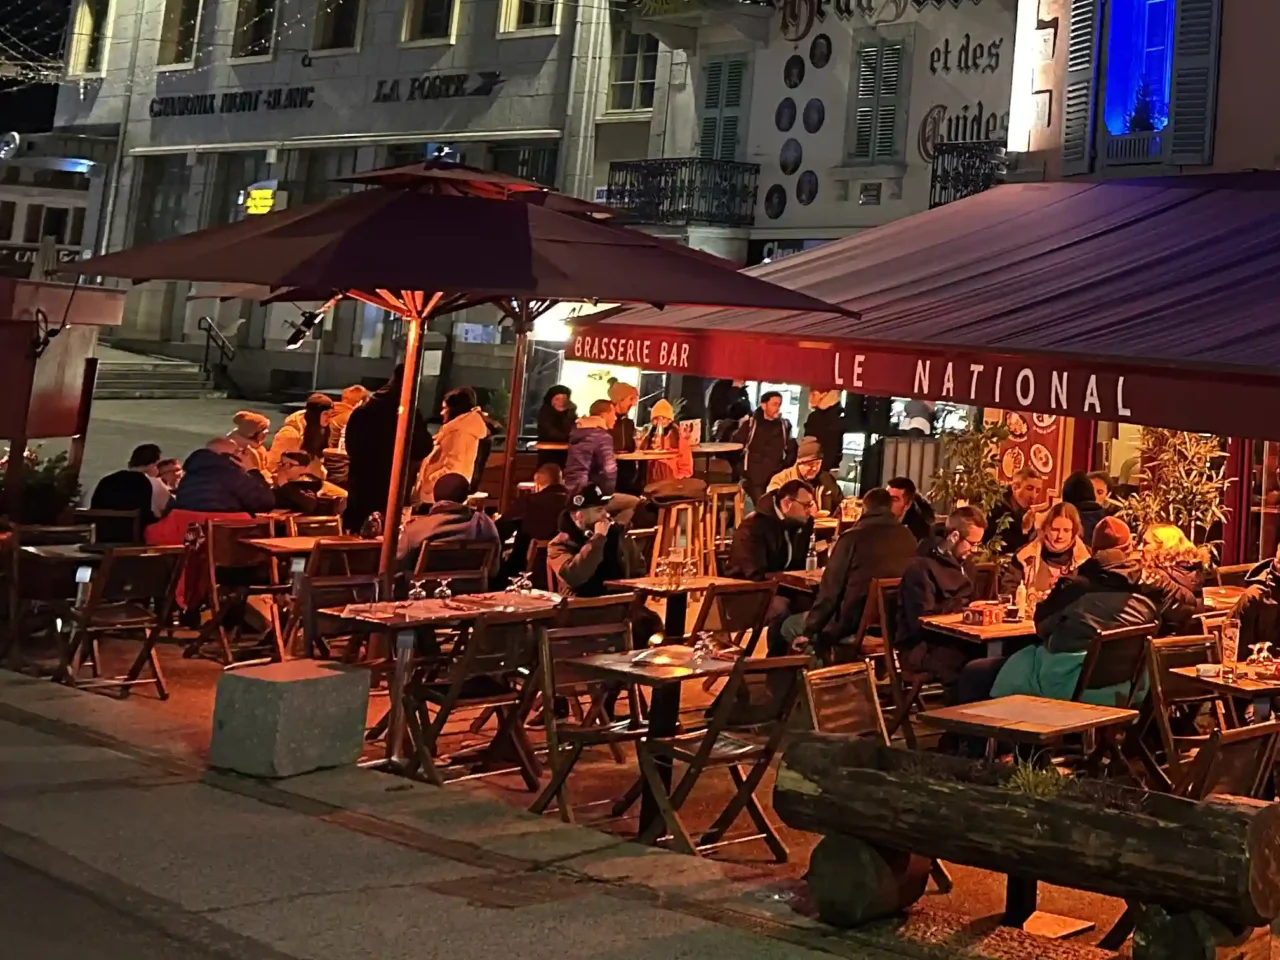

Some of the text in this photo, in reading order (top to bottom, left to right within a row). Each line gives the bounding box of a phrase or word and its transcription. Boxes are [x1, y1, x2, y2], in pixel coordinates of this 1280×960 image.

[929, 33, 1003, 76] et des
[373, 79, 401, 103] LA
[574, 336, 690, 368] BRASSERIE BAR
[834, 352, 1132, 417] LE NATIONAL
